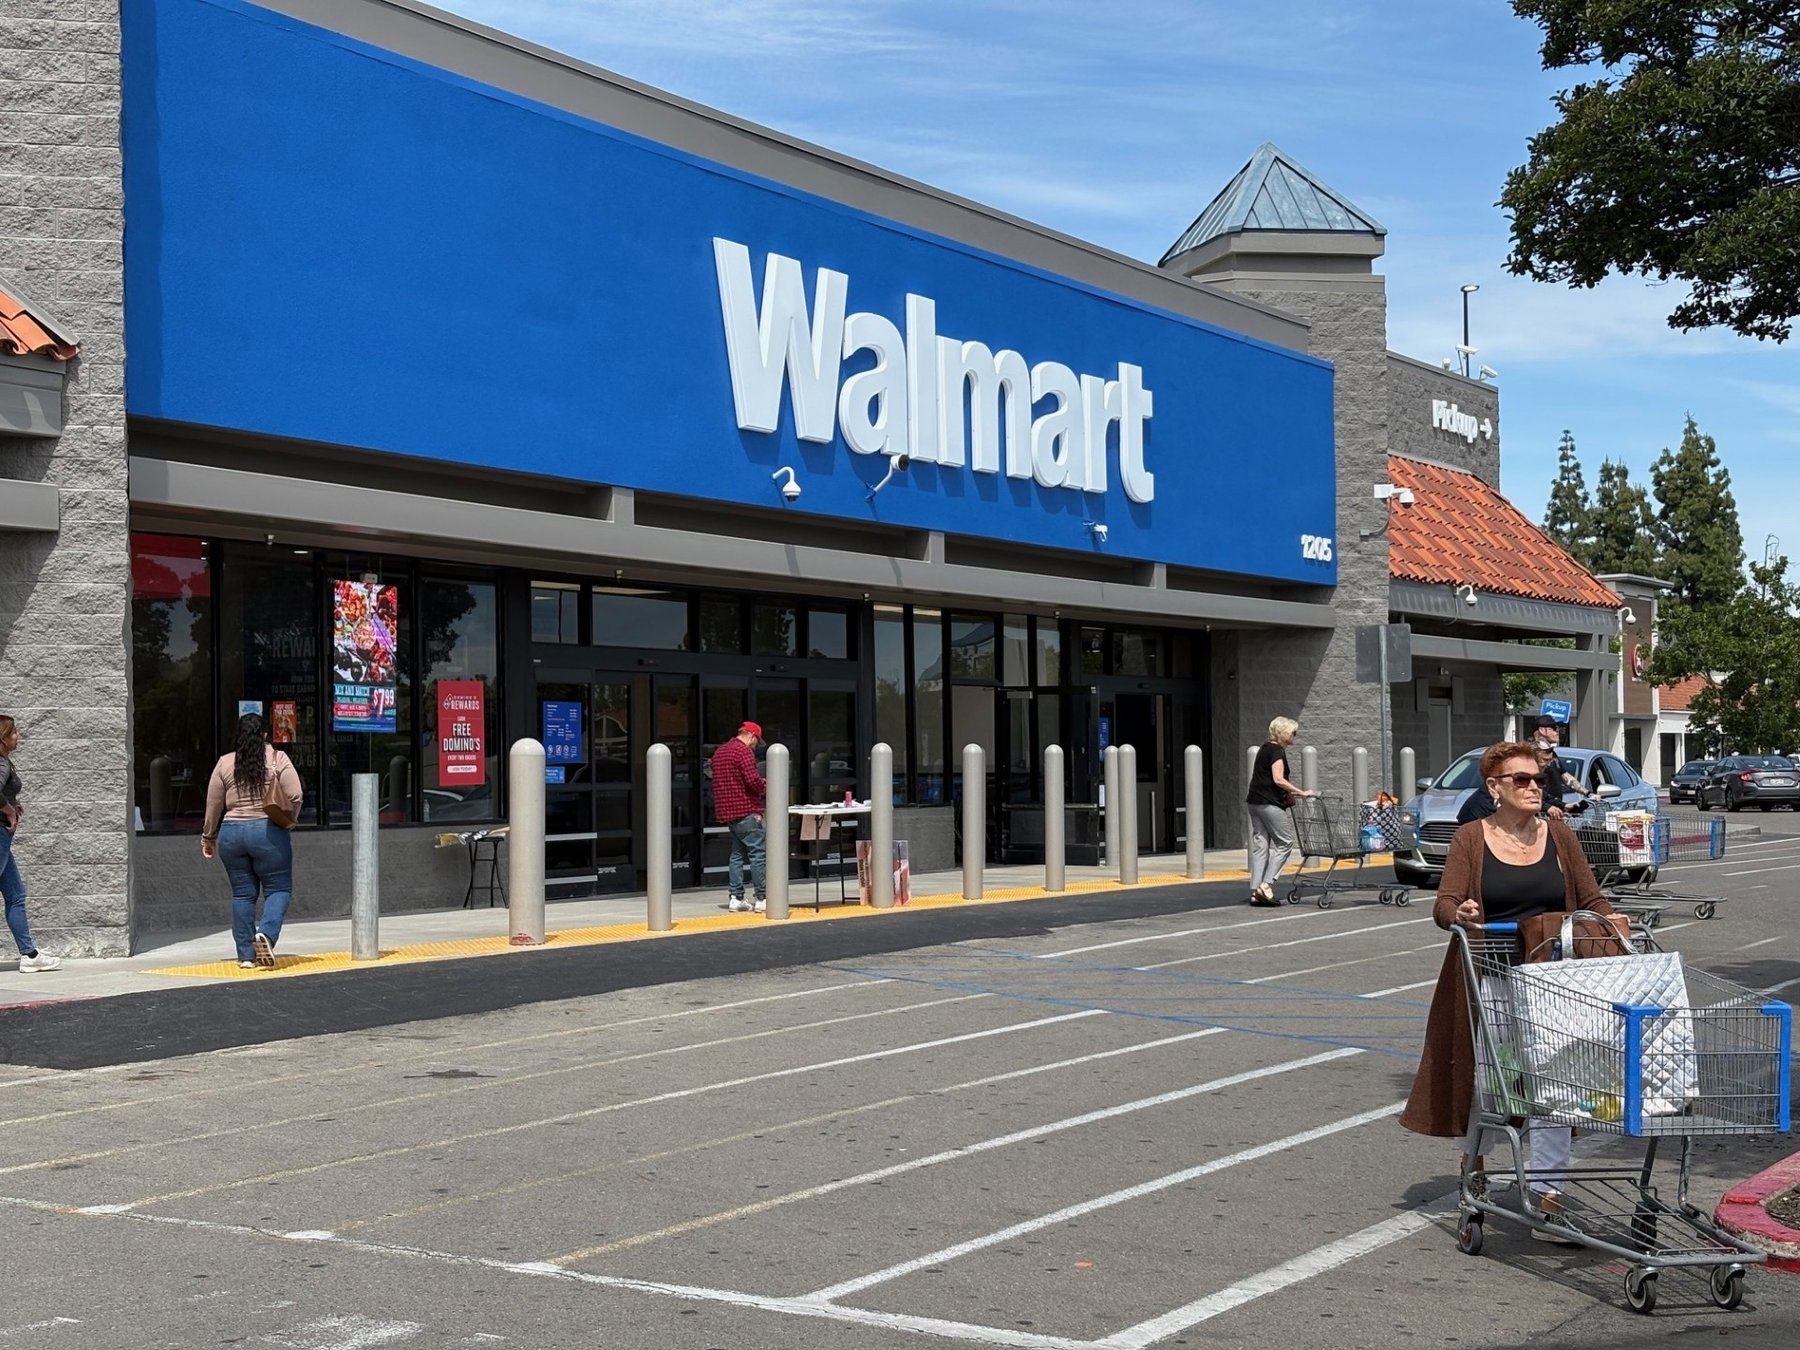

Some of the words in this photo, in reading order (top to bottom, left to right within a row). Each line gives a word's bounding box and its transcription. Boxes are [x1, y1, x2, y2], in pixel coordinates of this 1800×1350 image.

[713, 237, 1154, 503] Walmart
[1432, 399, 1478, 443] Pickup
[450, 700, 480, 710] REWARDS
[1546, 702, 1567, 712] Pickup
[452, 723, 472, 736] FREE
[443, 738, 481, 751] DOMINO'S
